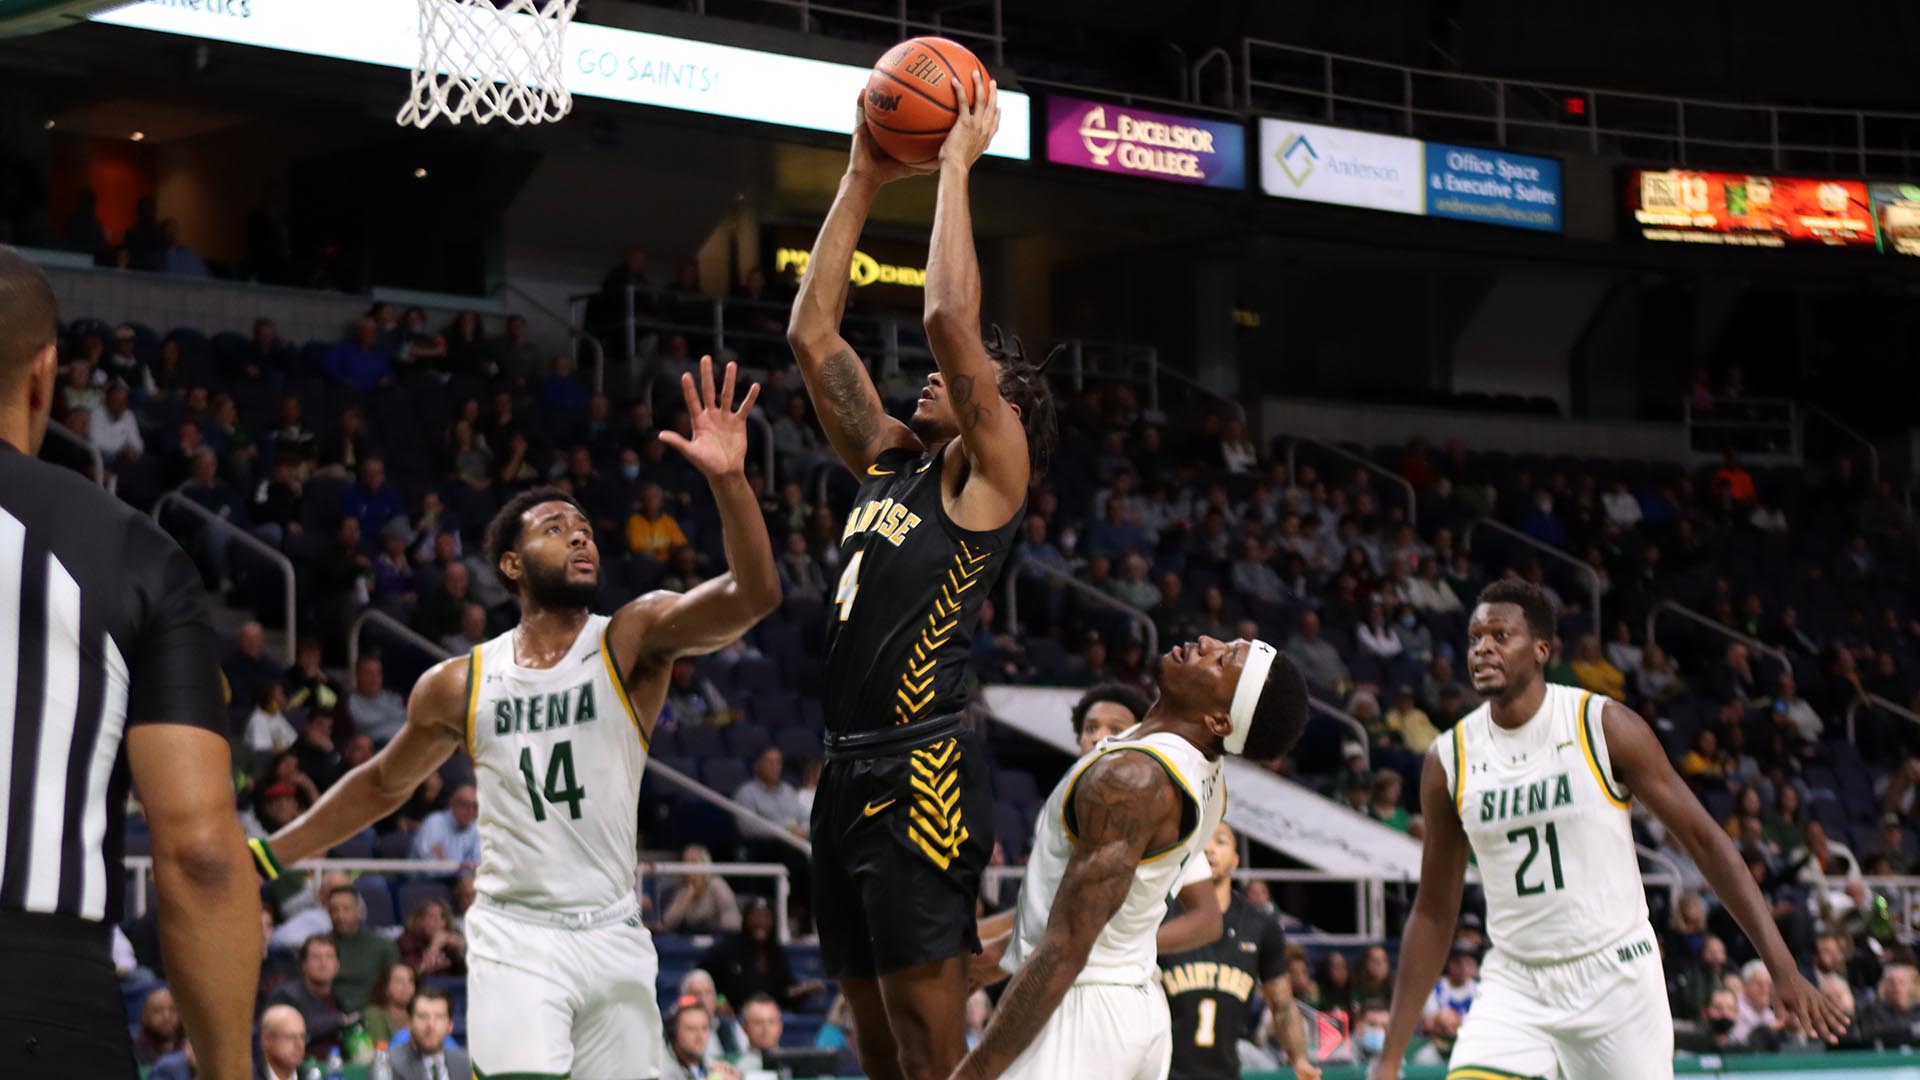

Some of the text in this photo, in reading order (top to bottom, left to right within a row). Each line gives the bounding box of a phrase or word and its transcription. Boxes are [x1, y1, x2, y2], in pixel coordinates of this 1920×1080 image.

[578, 49, 721, 93] GO SAINTS!
[904, 53, 946, 88] THE
[1117, 114, 1216, 154] EXCELSIOR
[1444, 172, 1513, 200] Executive
[1514, 180, 1557, 206] Suites
[1446, 151, 1540, 182] Office Space
[835, 550, 865, 621] 4
[494, 680, 597, 737] SIENA
[520, 740, 586, 822] 14
[1480, 773, 1574, 822] SIENA
[1506, 821, 1565, 897] 21
[1163, 962, 1218, 997] SAINT
[1195, 998, 1217, 1048] 1
